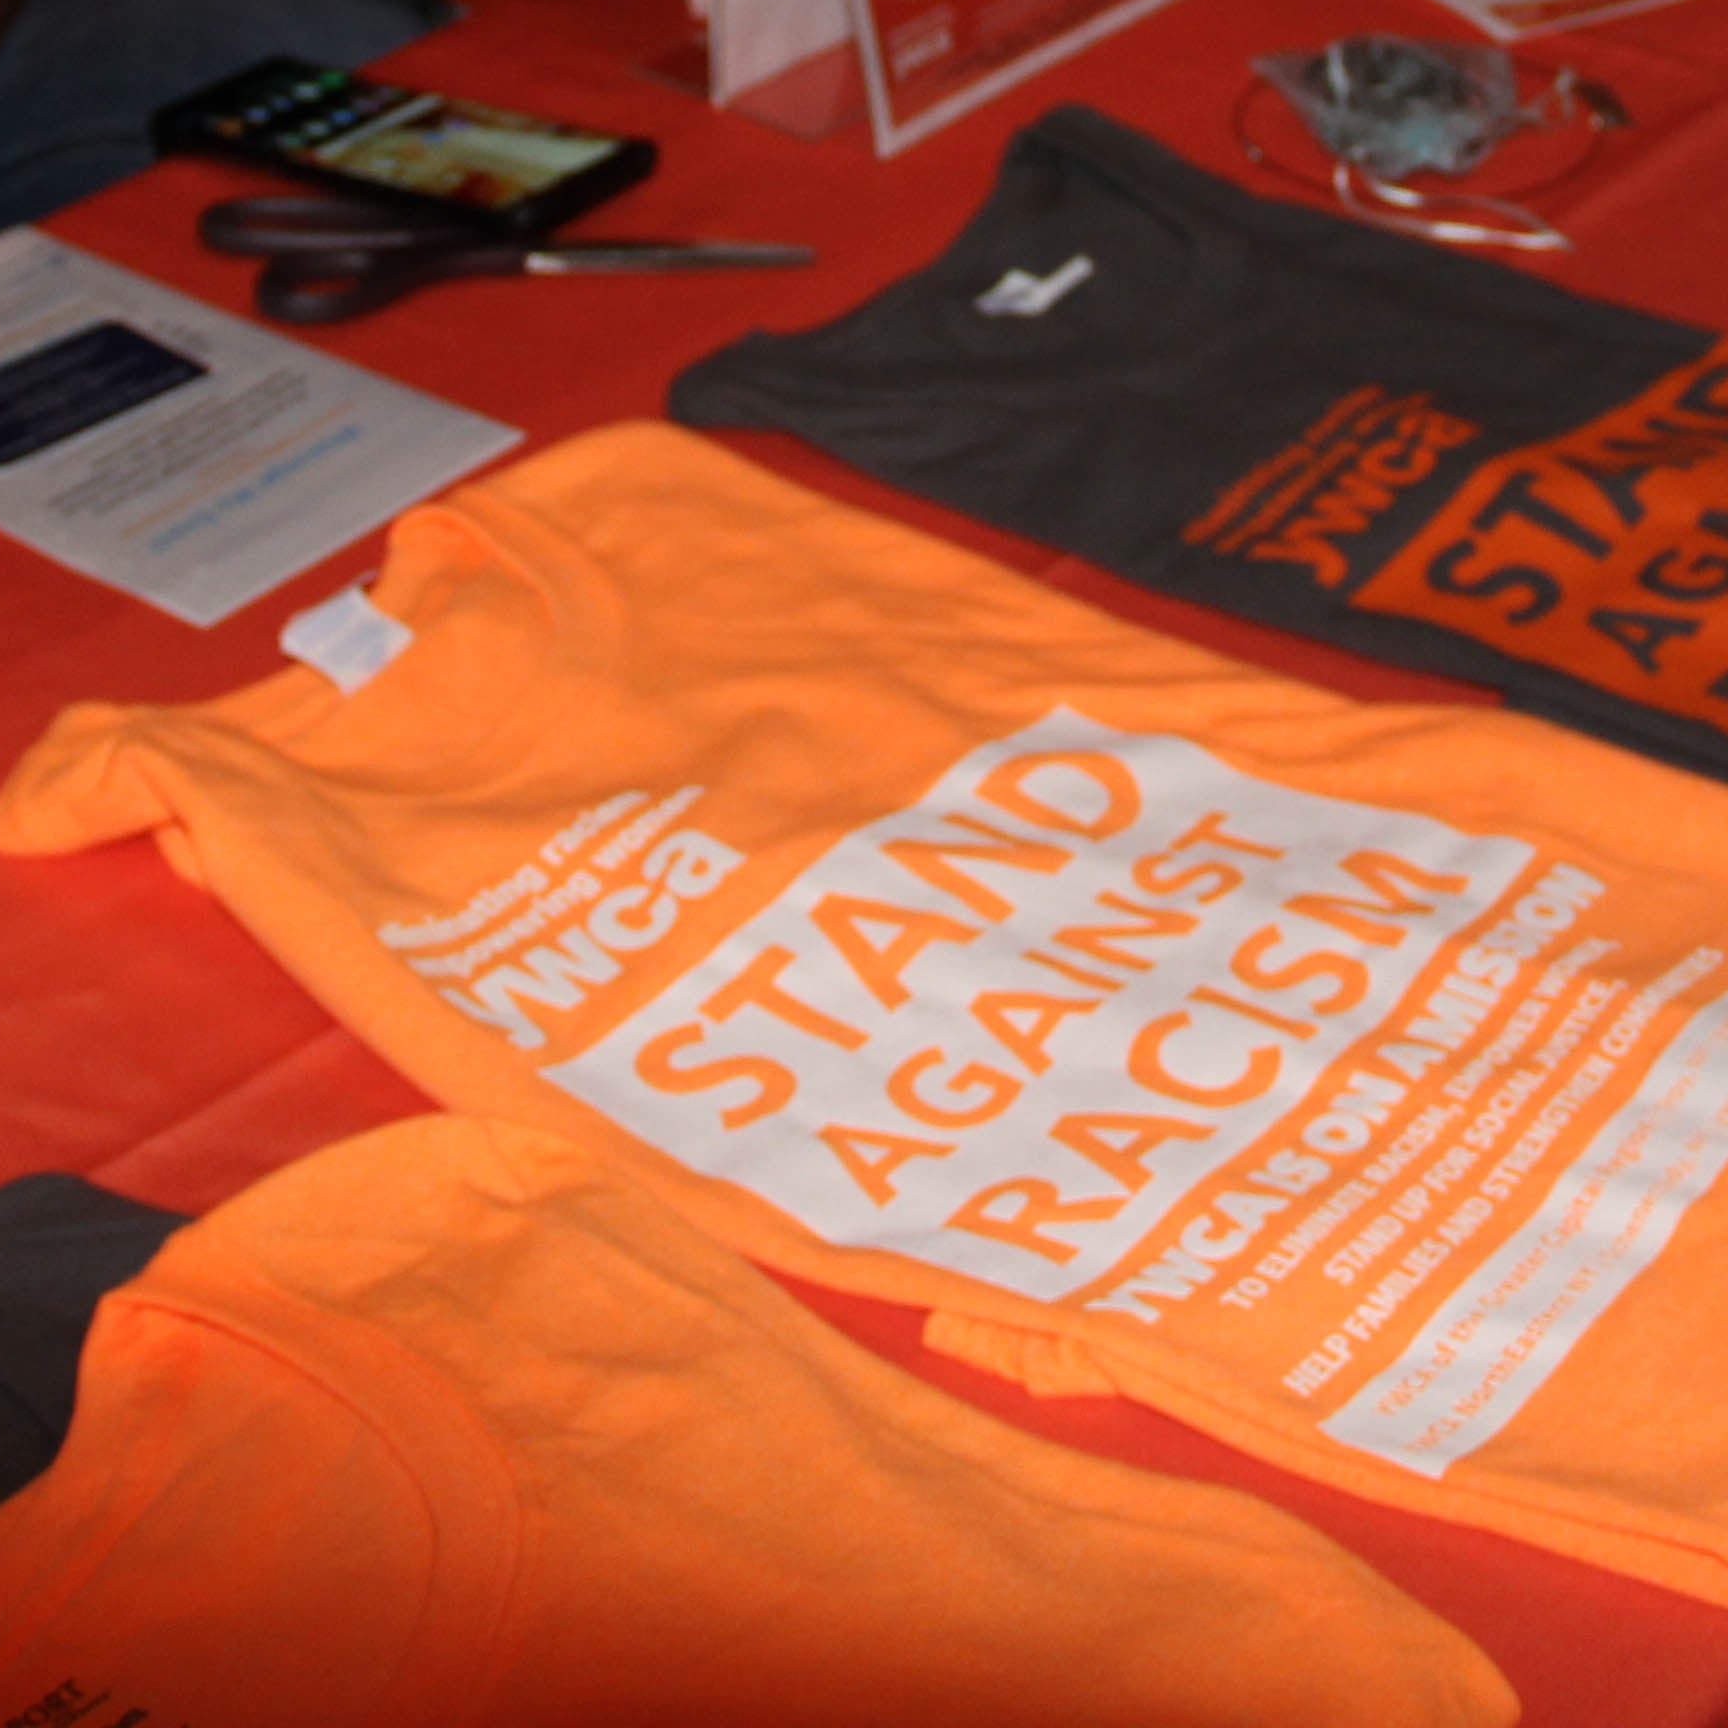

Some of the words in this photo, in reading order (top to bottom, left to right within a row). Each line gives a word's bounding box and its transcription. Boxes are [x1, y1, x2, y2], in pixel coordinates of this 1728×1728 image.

[438, 829, 747, 1050] ywca
[633, 750, 1142, 1133] STAND
[816, 811, 1288, 1209] AGAINST
[1405, 861, 1608, 1050] MISSION
[941, 849, 1469, 1264] RACISM
[1301, 1071, 1409, 1155] ON
[1376, 1039, 1449, 1082] A
[1081, 1189, 1291, 1326] YWCA
[1219, 1276, 1269, 1310] TO
[1255, 1179, 1380, 1281] ELIMINATE
[1246, 1148, 1332, 1196] IS
[1280, 1332, 1353, 1399] HELP
[1343, 1236, 1453, 1343] FAMILIES
[1436, 1195, 1494, 1248] AND
[1479, 1053, 1618, 1201] STRENGTHEN
[1324, 1215, 1406, 1286] STAND
[1389, 1184, 1432, 1223] UP
[1422, 1146, 1480, 1193] FOR
[1462, 1068, 1549, 1149] SOCIAL
